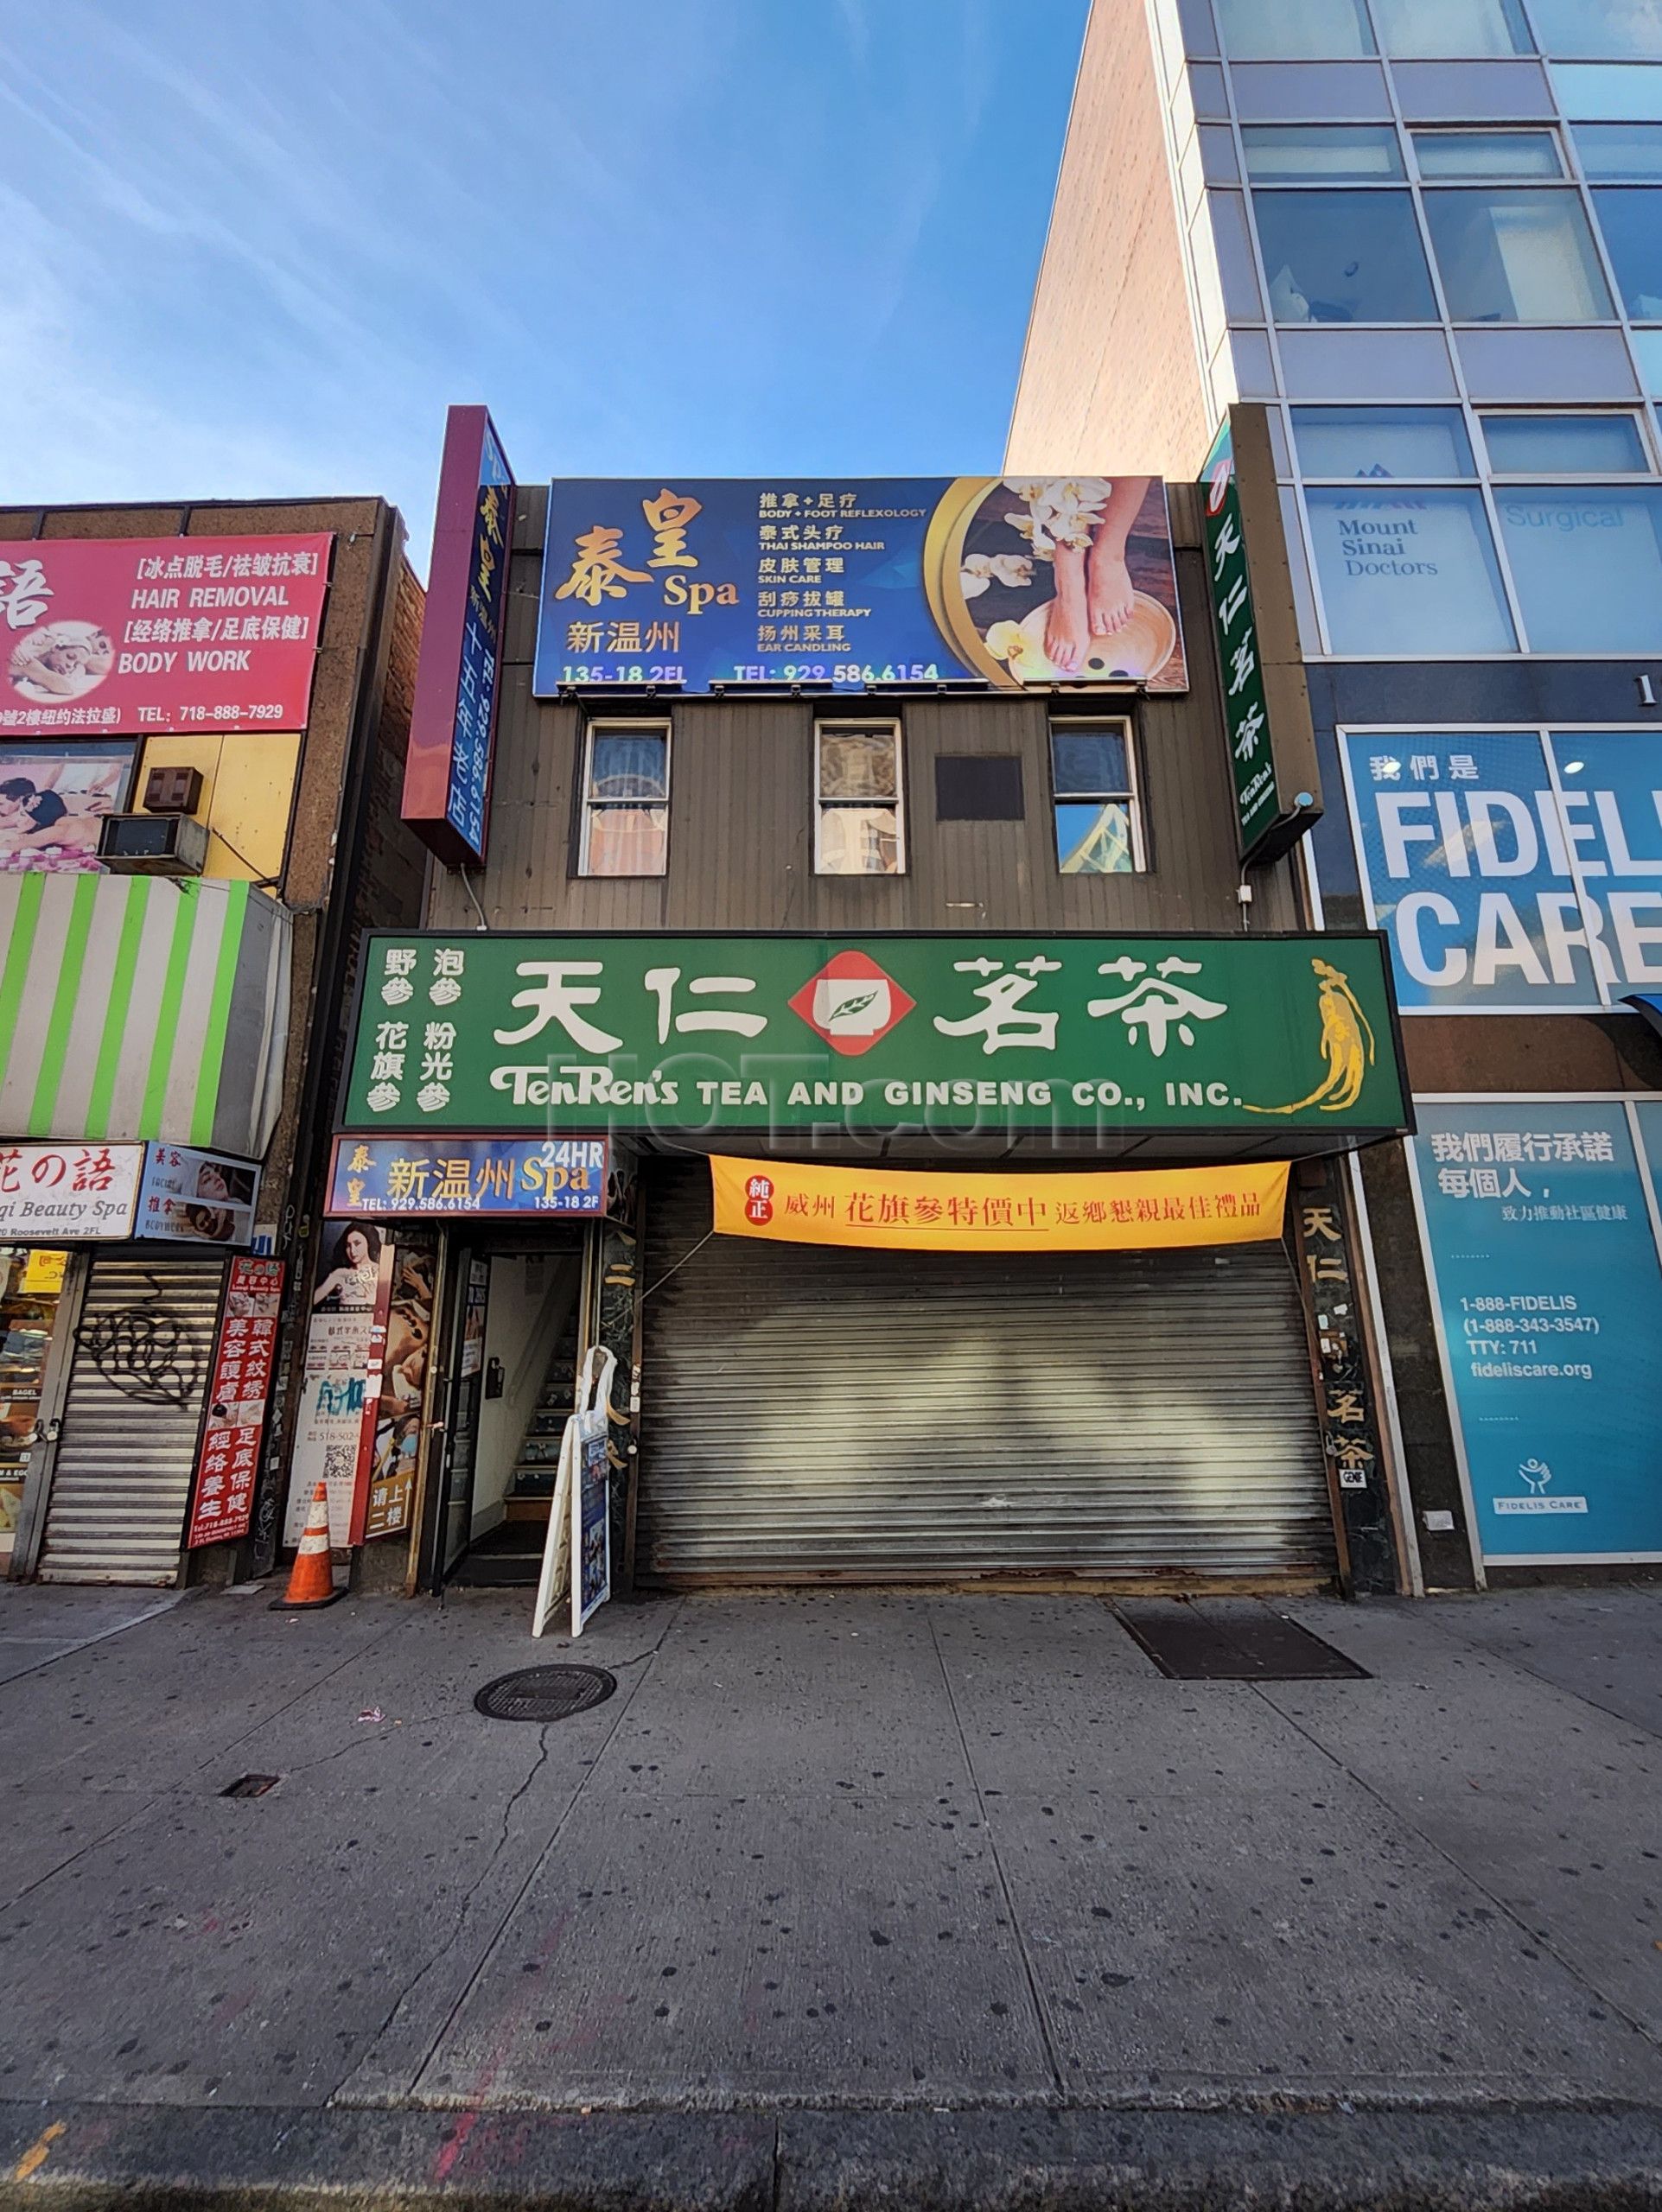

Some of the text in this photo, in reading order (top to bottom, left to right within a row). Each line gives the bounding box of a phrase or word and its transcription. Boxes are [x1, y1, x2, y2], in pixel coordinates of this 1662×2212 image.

[840, 509, 927, 518] REFLEXOLOGY
[1505, 505, 1625, 532] Surgical
[758, 524, 844, 540] 泰式头疗
[1338, 518, 1419, 536] Mount
[758, 542, 885, 550] THAI SHAMPOO HAIR
[1341, 537, 1405, 556] Sinai
[758, 557, 844, 573] 皮肤管理
[1345, 560, 1438, 576] Doctors
[758, 575, 822, 583] SKIN CARE
[131, 585, 290, 609] HAIR REMOVAL
[663, 574, 740, 614] Spa
[757, 590, 844, 607] 刮痧拔罐
[757, 608, 872, 617] CUPPING THERAPY
[567, 621, 679, 653] 新温州
[757, 625, 844, 641] 扬州采耳
[1213, 514, 1264, 762] 天仁茗茶
[784, 643, 851, 652] CANDLING
[118, 649, 252, 674] BODY WORK
[180, 704, 283, 721] 718-888-7929
[1395, 891, 1662, 987] CARE
[696, 1080, 768, 1106] TEA
[786, 1080, 865, 1106] AND
[884, 1081, 1053, 1107] GINSENG
[1072, 1081, 1147, 1112] CO.,
[1165, 1081, 1243, 1107] INC.
[541, 1141, 603, 1168] 24HR
[1431, 1132, 1614, 1162] 我們履行承諾
[386, 1158, 515, 1199] 新温州
[521, 1155, 590, 1200] Spa
[361, 1196, 481, 1211] TEL: 929.586.6154
[533, 1196, 600, 1210] 135-18 2F
[748, 1179, 770, 1220] 純正
[19, 1201, 87, 1221] Beauty
[92, 1200, 127, 1219] Spa
[1460, 1295, 1577, 1311] 1-888-FIDELIS
[1463, 1317, 1600, 1336] (1-888-343-3547)
[1466, 1339, 1537, 1355] TTY: 711
[1470, 1362, 1593, 1380] fideliscare.org
